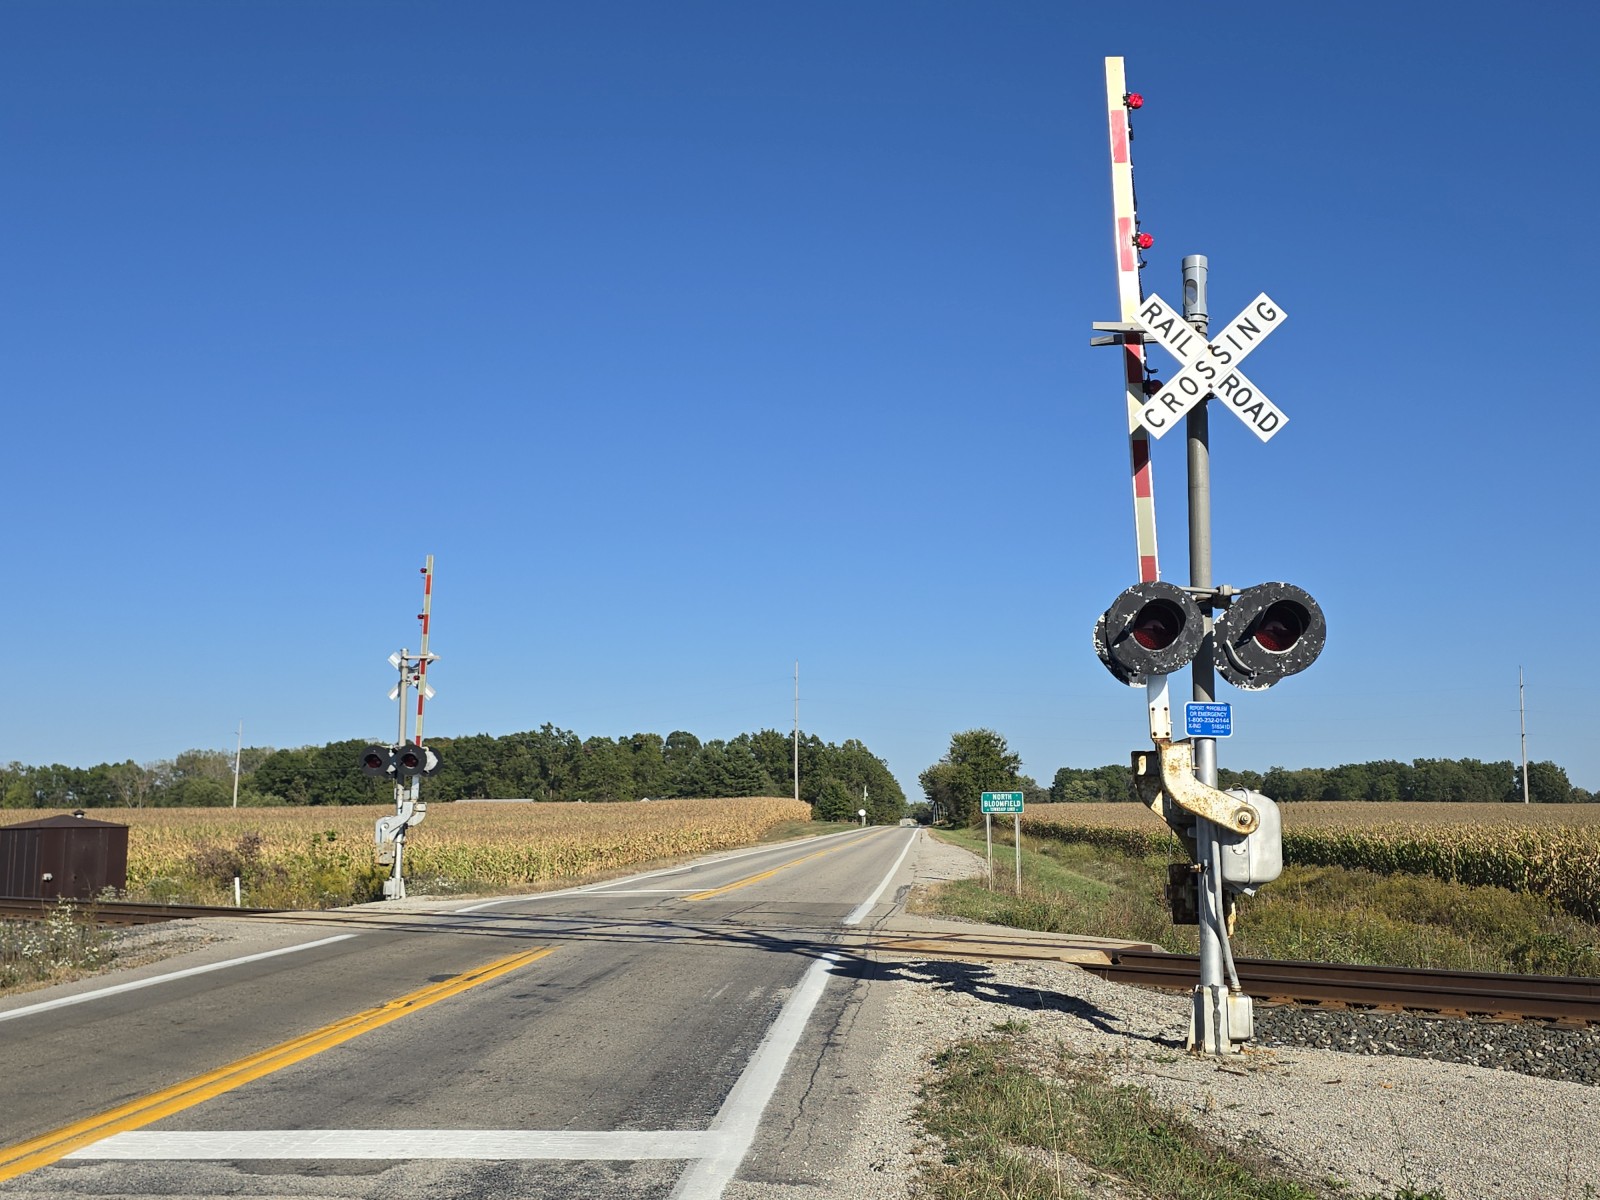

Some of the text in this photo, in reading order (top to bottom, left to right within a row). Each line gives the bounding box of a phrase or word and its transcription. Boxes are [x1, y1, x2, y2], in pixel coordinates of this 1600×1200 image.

[1140, 302, 1279, 433] RAIL ROAD
[1144, 301, 1277, 428] CROSSING
